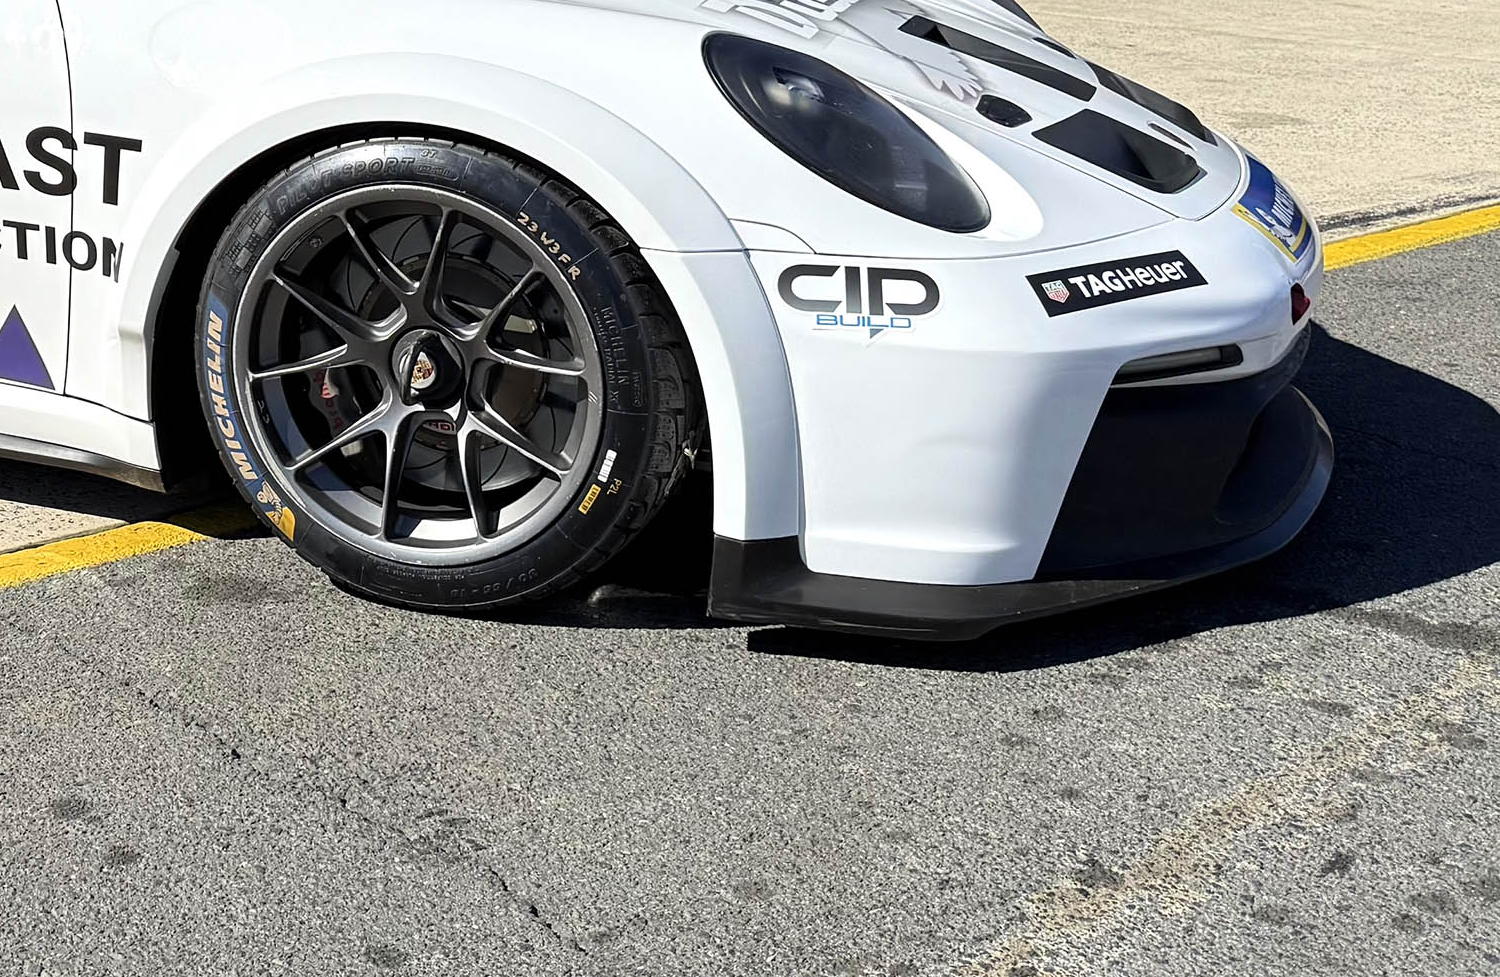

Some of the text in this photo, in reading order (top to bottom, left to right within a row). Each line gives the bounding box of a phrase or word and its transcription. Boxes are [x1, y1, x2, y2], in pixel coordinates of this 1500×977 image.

[517, 210, 539, 232] 23
[816, 314, 912, 329] BUILD
[206, 310, 259, 481] MICHELIN
